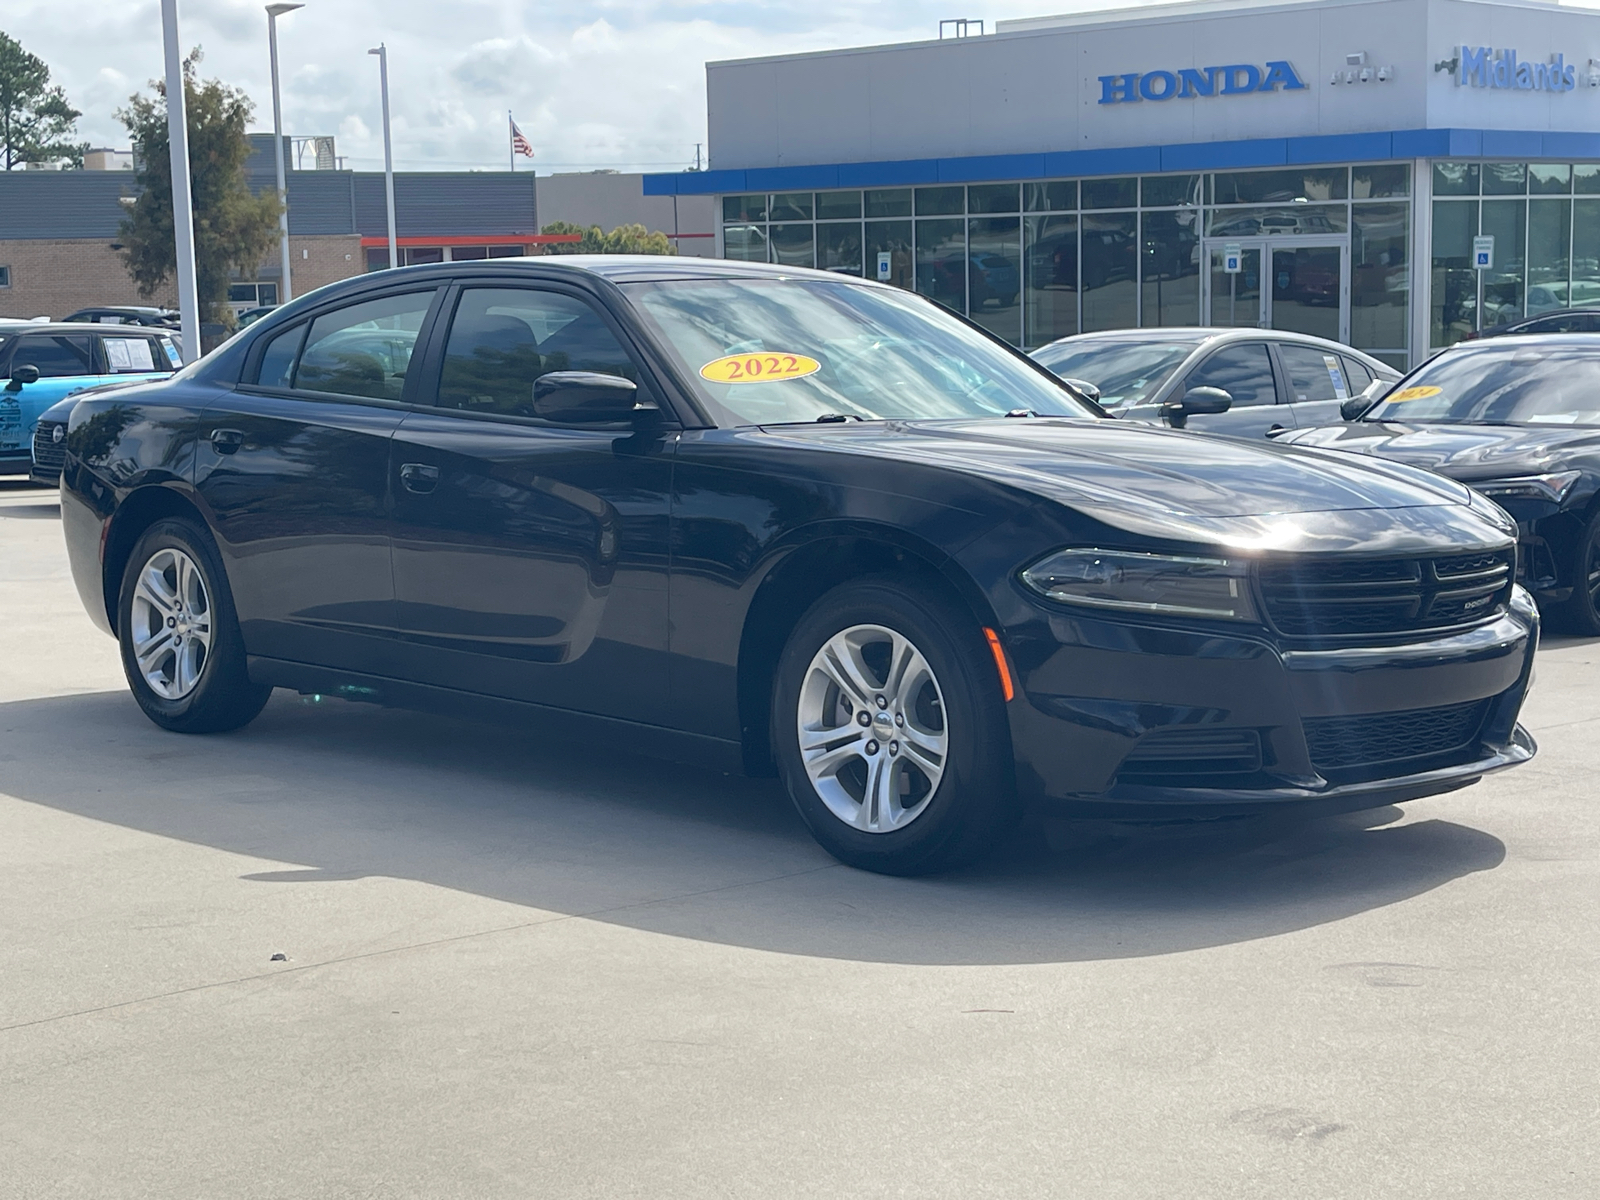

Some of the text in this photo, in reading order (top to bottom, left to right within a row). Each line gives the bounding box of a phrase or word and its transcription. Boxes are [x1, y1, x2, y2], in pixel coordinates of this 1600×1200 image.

[1097, 60, 1306, 105] HONDA
[1461, 45, 1576, 92] Midlands
[725, 356, 800, 380] 2022
